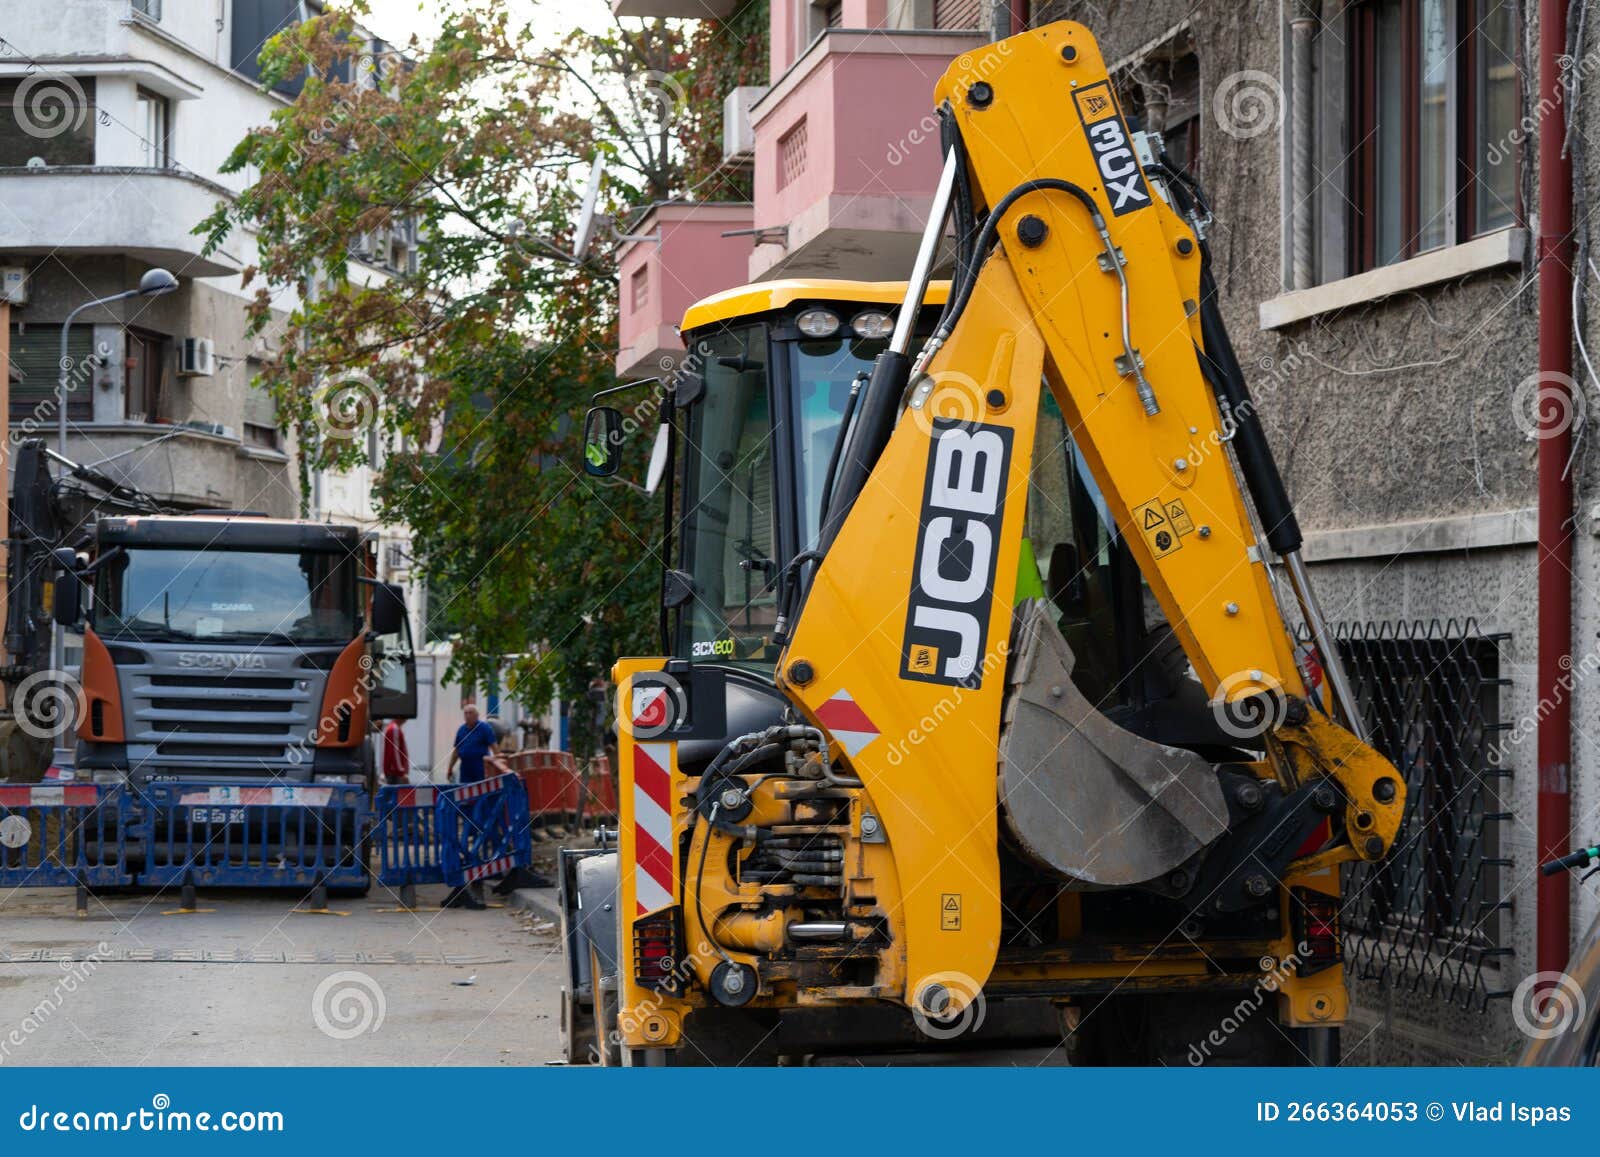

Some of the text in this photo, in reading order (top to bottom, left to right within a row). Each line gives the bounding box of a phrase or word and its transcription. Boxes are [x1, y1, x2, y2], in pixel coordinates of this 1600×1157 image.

[1090, 120, 1149, 209] 3CX
[913, 428, 1004, 678] JCB
[178, 653, 266, 669] SCANIA
